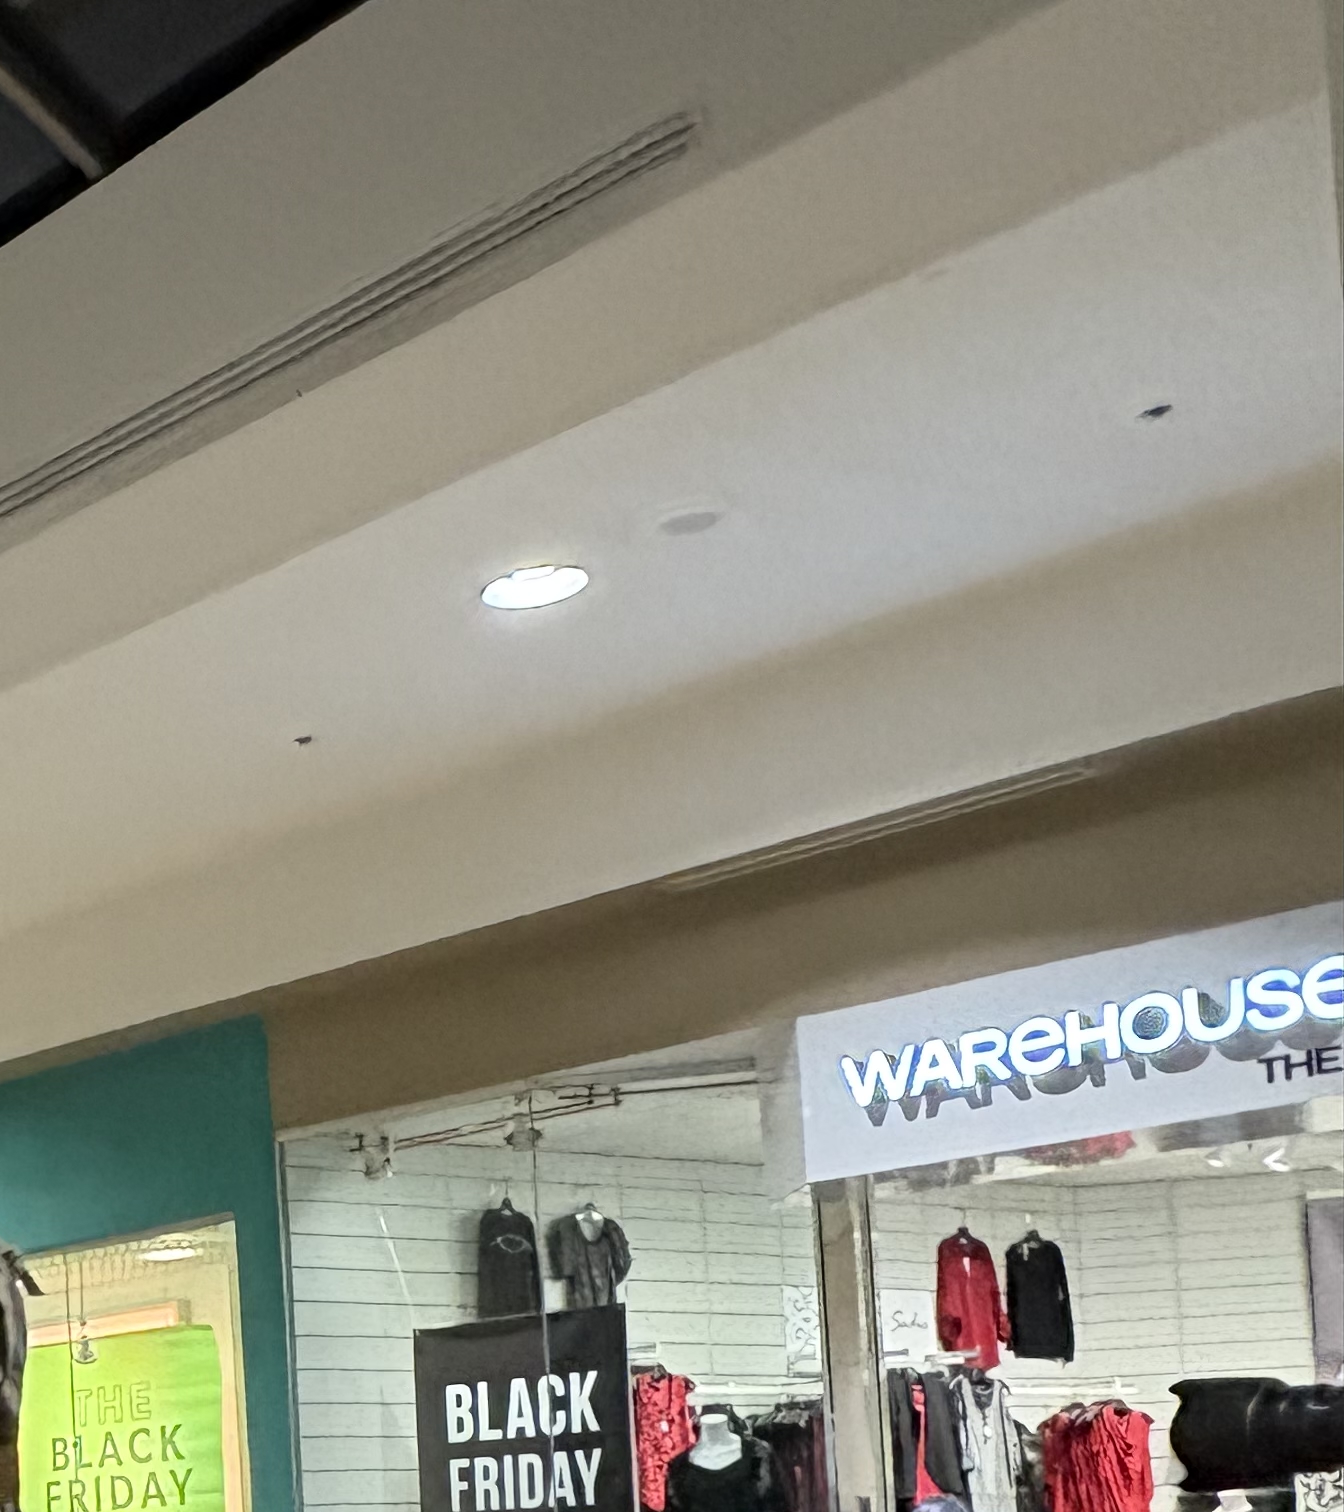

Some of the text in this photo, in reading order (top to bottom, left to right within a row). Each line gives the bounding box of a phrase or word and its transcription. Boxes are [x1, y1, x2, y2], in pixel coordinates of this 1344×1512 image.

[76, 1381, 152, 1428] THE
[444, 1369, 601, 1445] BLACK
[51, 1424, 186, 1472] BLACK
[448, 1447, 603, 1512] FRIDAY
